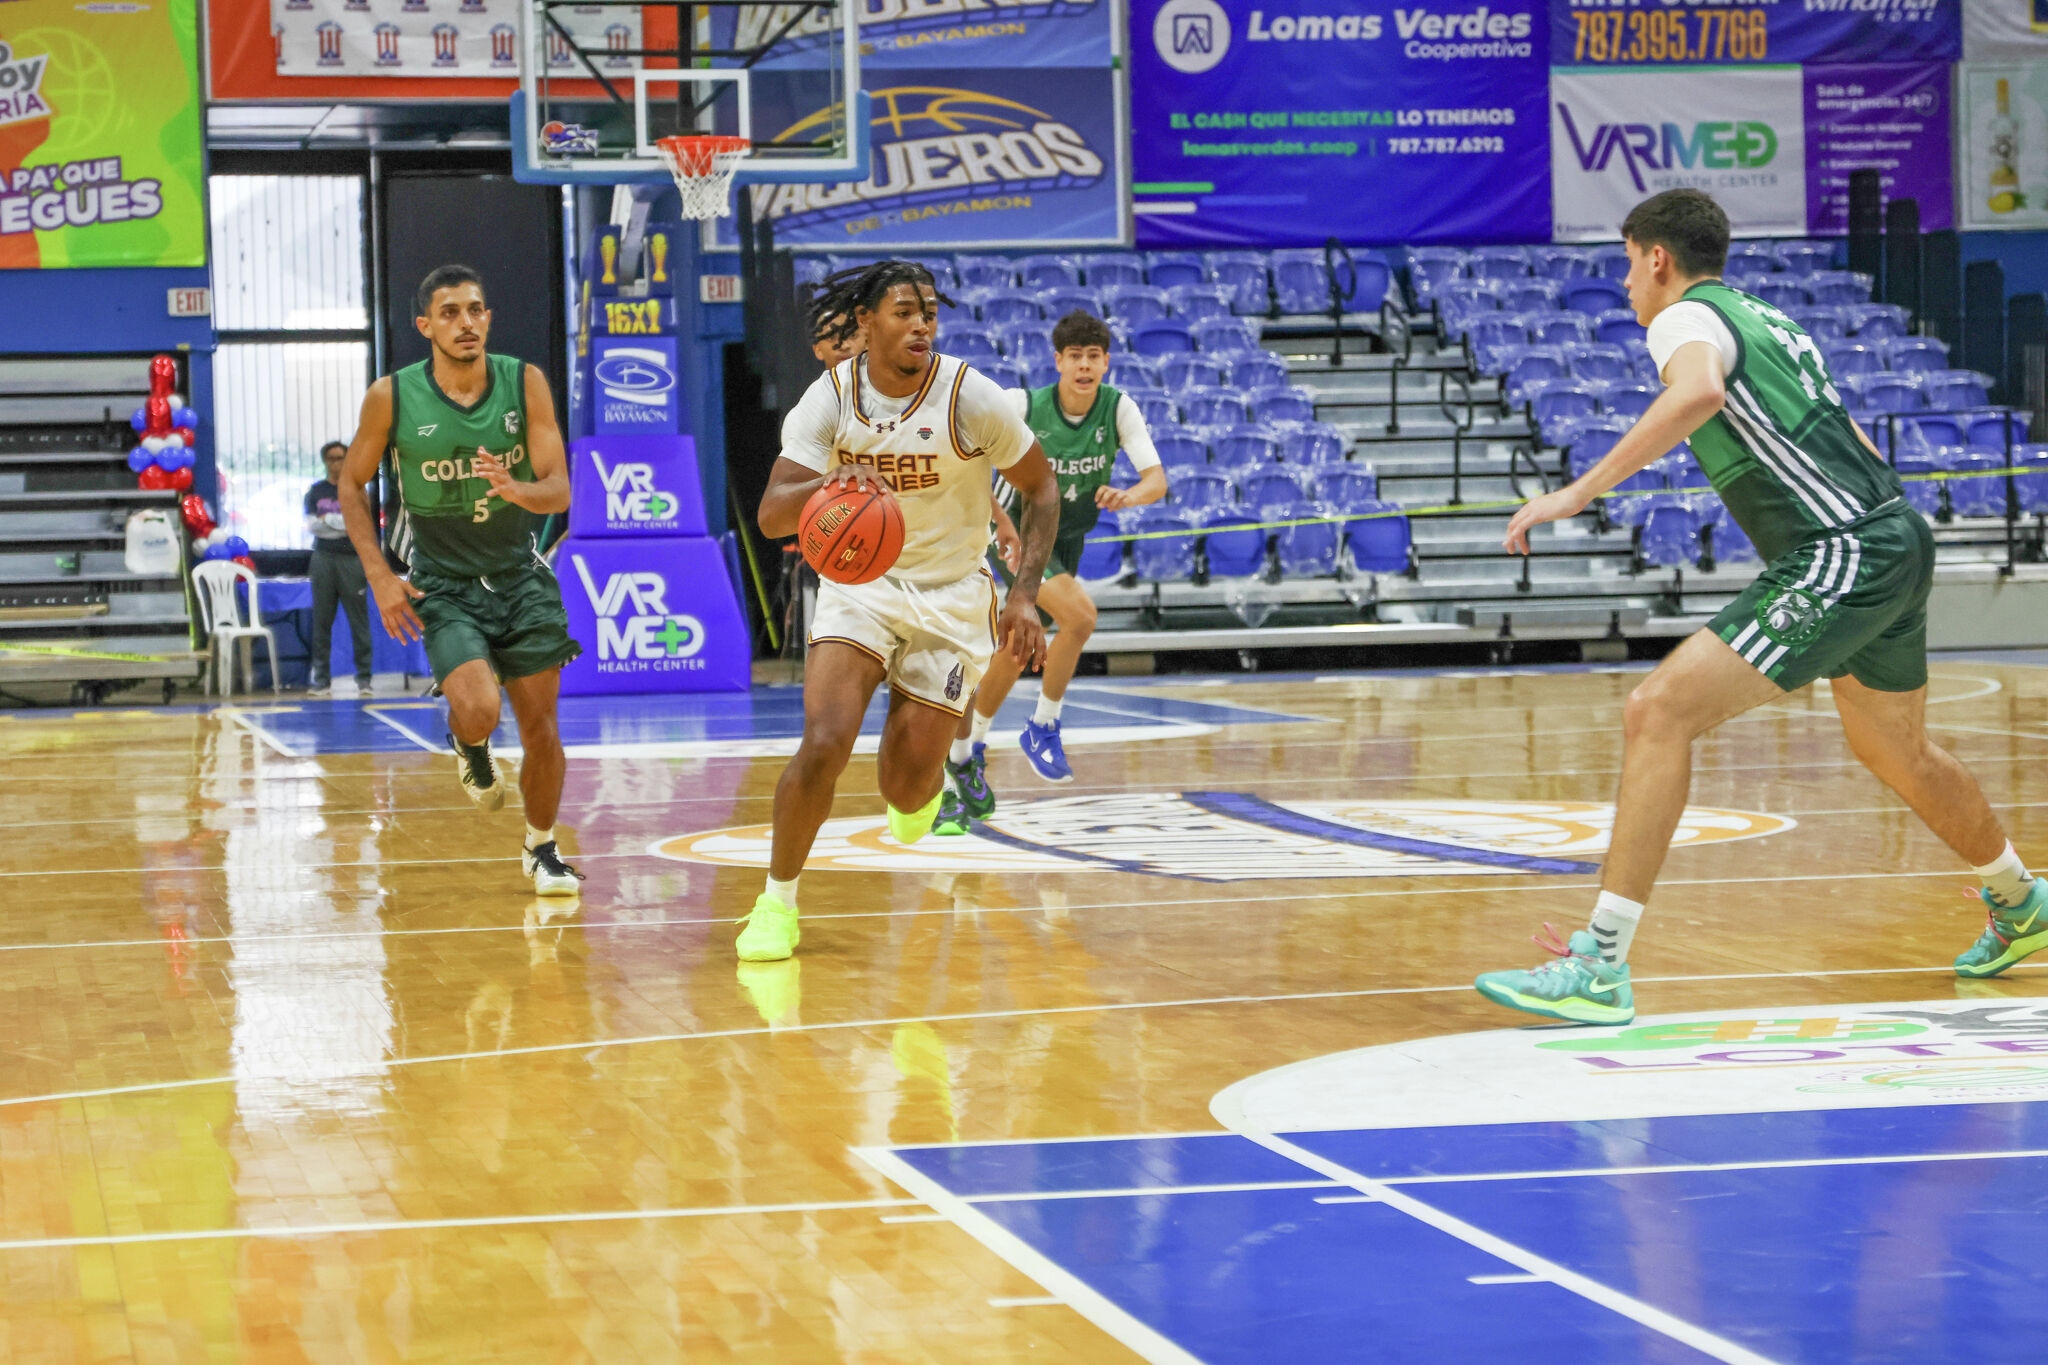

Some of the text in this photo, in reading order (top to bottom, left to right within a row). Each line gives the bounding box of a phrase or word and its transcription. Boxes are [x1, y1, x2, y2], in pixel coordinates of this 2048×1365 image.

[1247, 6, 1531, 41] Lomas Verdes
[1572, 10, 1766, 61] 787.395.7766
[1404, 39, 1531, 60] Cooperativa
[1170, 113, 1191, 128] EL
[1250, 111, 1289, 129] QUE
[1396, 110, 1423, 126] LO
[1425, 108, 1515, 125] TENEMOS
[1557, 101, 1778, 193] VARMED
[62, 158, 120, 185] QUE
[1653, 174, 1778, 188] HEALTH CENTER
[1, 181, 162, 233] EGUES
[902, 196, 1032, 222] BAYAMON
[176, 291, 204, 312] EXIT
[708, 278, 734, 299] EXIT
[590, 450, 655, 493] VAR
[882, 472, 940, 492] NES
[1064, 483, 1078, 502] 4
[472, 497, 490, 523] 5
[606, 491, 679, 521] MED
[606, 520, 679, 530] HEALTH CENTER
[571, 554, 670, 617] VAR
[596, 614, 705, 661] MED
[597, 658, 705, 673] HEALTH CENTER
